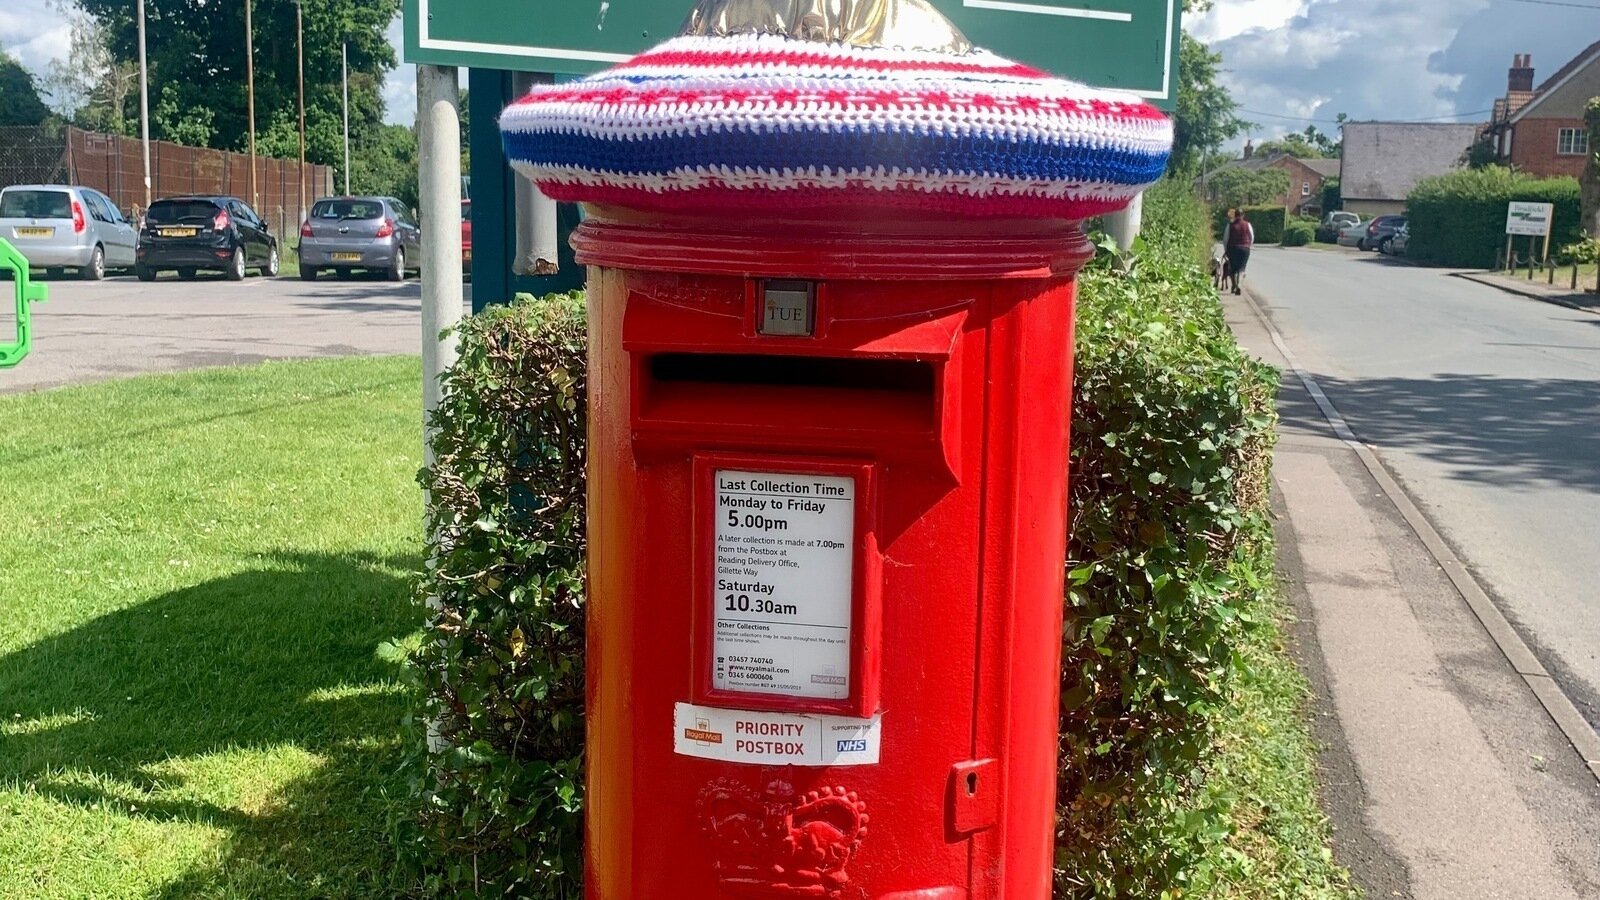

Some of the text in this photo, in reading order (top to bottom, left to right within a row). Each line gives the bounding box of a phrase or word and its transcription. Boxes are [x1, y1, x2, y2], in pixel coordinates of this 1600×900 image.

[769, 307, 802, 321] TUE
[720, 478, 845, 496] Last Collection Time
[720, 495, 826, 514] Monday to Friday
[728, 510, 788, 532] 5.00pm
[743, 537, 775, 546] collection
[816, 541, 845, 550] 7.00pm
[718, 546, 734, 554] from
[750, 547, 778, 556] Postbox
[718, 556, 800, 568] Reading Delivery Office,
[718, 567, 758, 578] Gillette Way
[718, 580, 774, 595] Saturday
[725, 594, 797, 615] 10.30am
[718, 622, 770, 631] Other Collections
[729, 665, 790, 674] www.royalmail.com
[830, 676, 844, 684] Mail
[736, 721, 804, 736] PRIORITY
[686, 730, 720, 742] Royal Mail
[736, 740, 804, 755] POSTBOX
[838, 740, 864, 750] NHS
